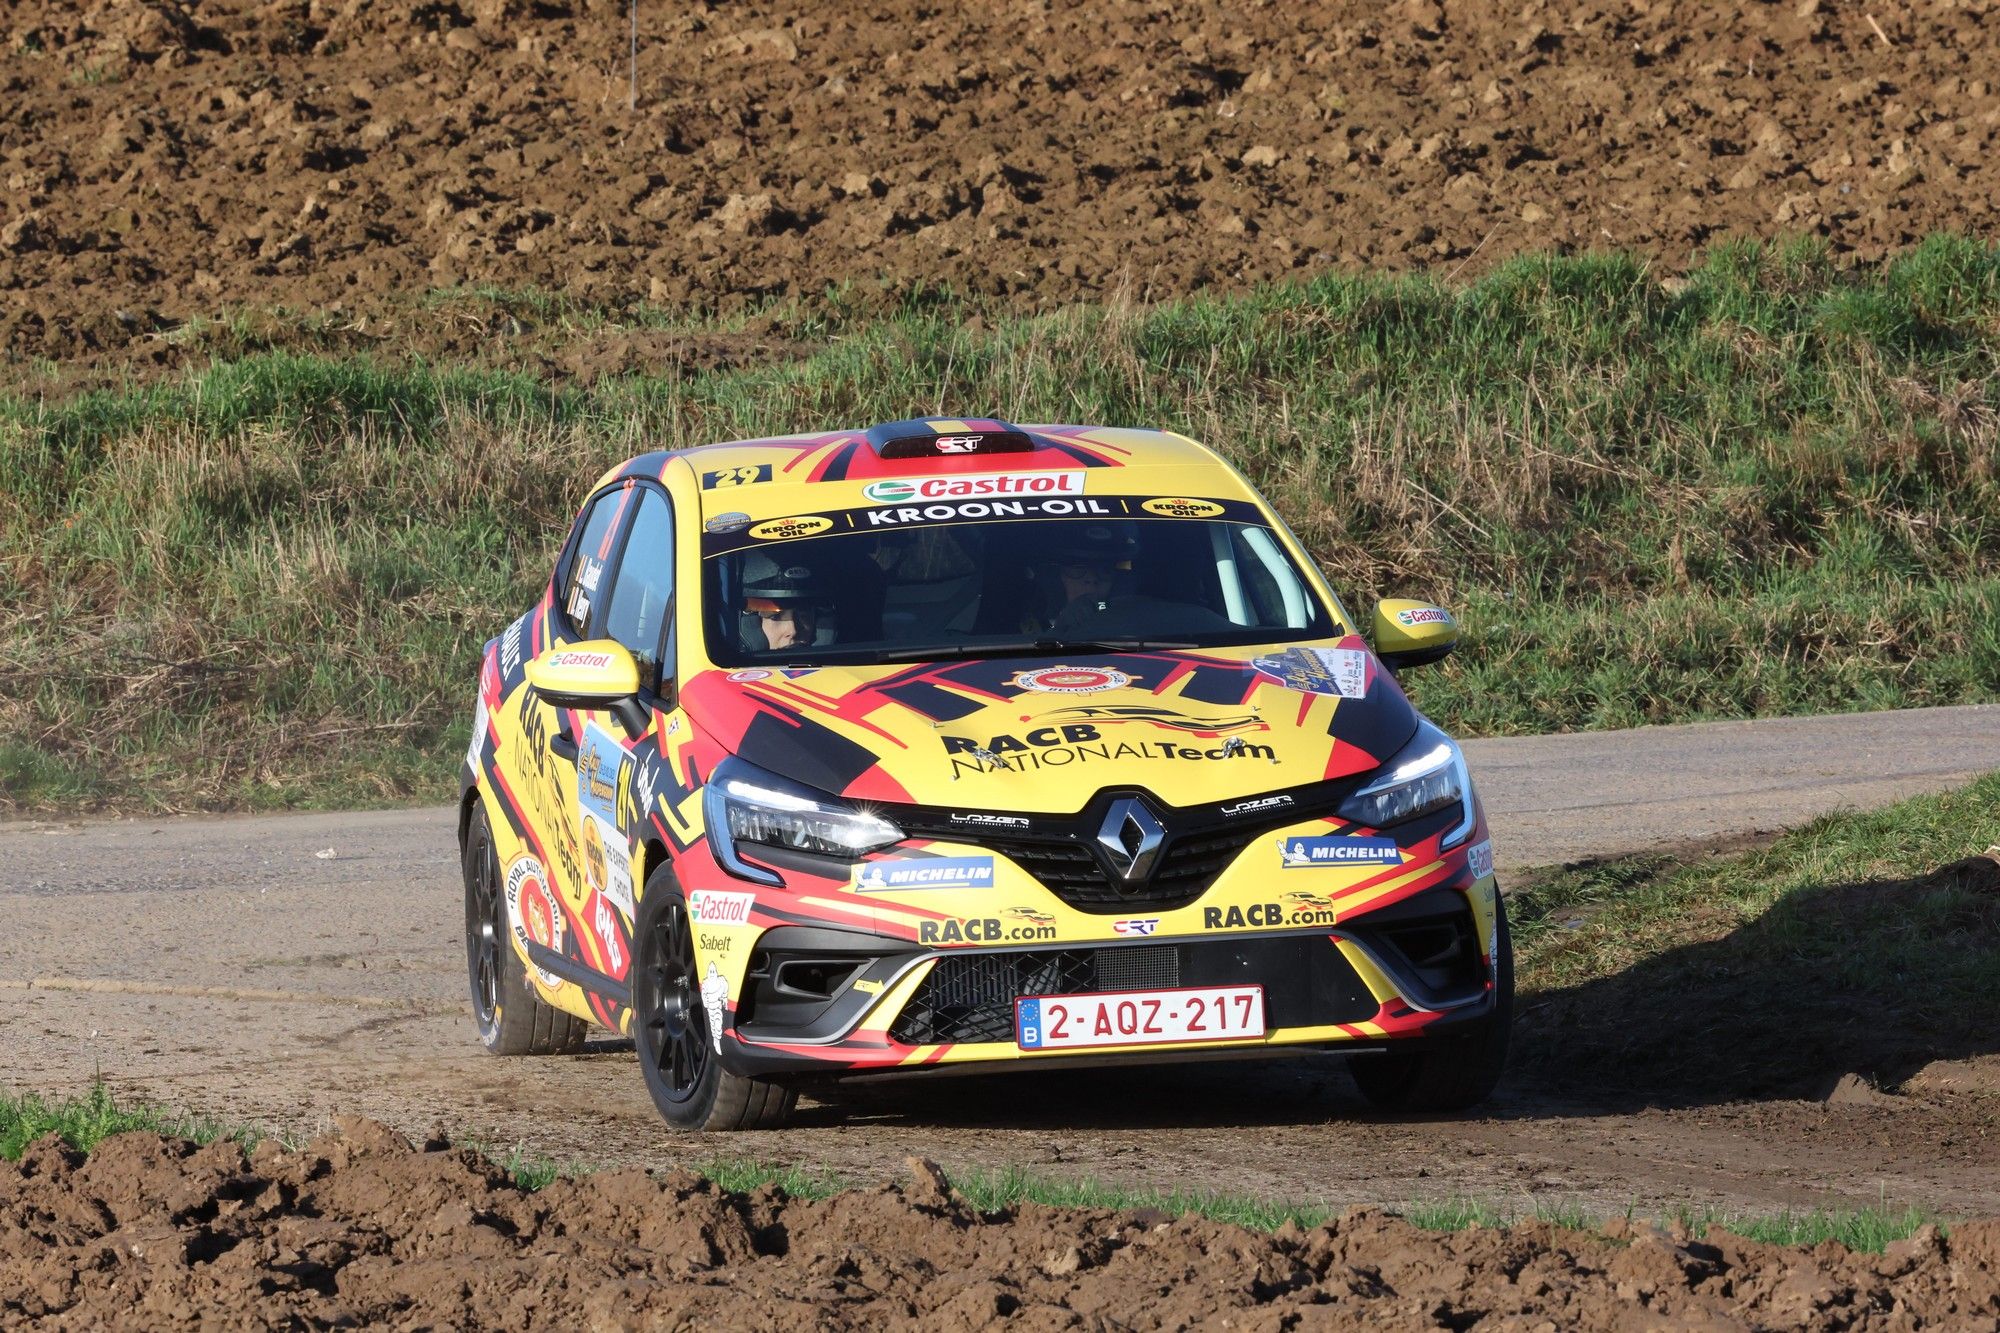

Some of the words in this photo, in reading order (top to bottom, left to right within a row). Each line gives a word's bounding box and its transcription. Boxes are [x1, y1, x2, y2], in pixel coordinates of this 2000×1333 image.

[715, 466, 760, 488] 29
[920, 475, 1072, 498] Castrol
[867, 499, 1110, 525] KROON-OIL
[760, 521, 821, 535] KROON
[779, 530, 806, 538] OIL
[1411, 609, 1447, 622] Castrol
[561, 653, 610, 667] Castrol
[941, 724, 1102, 755] RACB
[1311, 846, 1397, 859] MICHELIN
[507, 864, 527, 903] ROYAL
[889, 867, 992, 883] MICHELIN
[700, 895, 748, 921] Castrol
[1203, 903, 1334, 928] RACB.com
[920, 918, 1057, 943] RACB.com
[1113, 919, 1160, 935] CRT
[700, 933, 731, 951] Sabelt
[1048, 995, 1254, 1038] 2-AQZ-217
[1024, 1027, 1038, 1043] B
